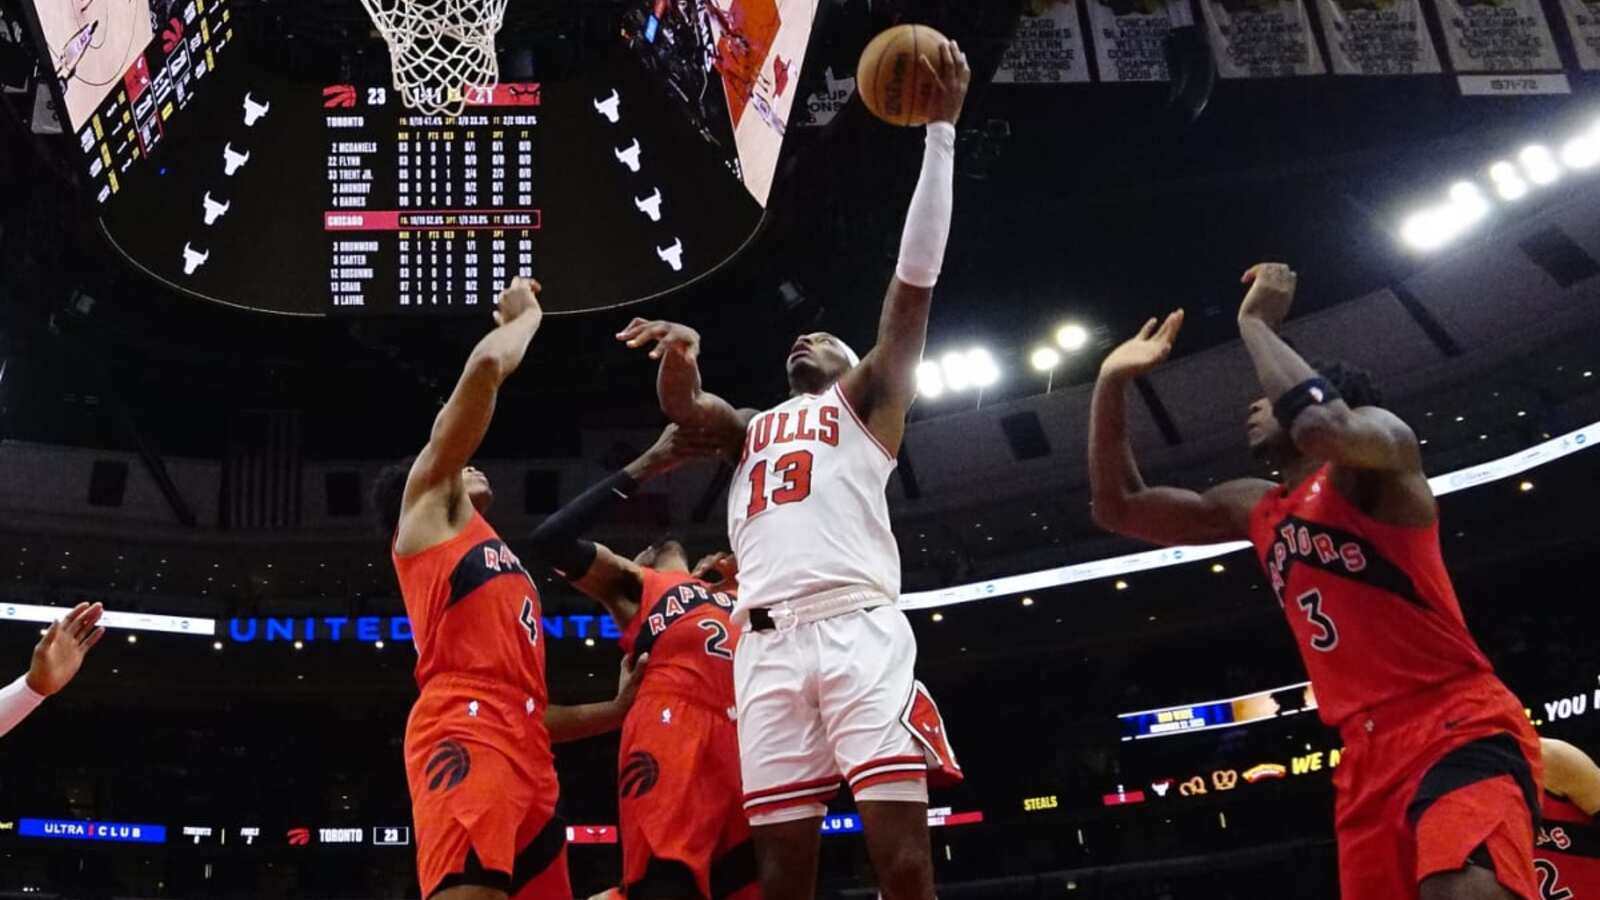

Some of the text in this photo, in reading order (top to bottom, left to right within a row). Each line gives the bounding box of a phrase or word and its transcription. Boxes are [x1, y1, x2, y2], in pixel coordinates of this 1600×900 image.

[367, 87, 386, 105] 23
[326, 116, 364, 127] TORONTO
[327, 215, 363, 226] CHICAGO
[747, 450, 813, 519] 13
[1267, 523, 1366, 608] APTORS
[519, 596, 538, 647] 4
[649, 585, 738, 636] RAPTO
[1298, 588, 1339, 652] 3
[698, 619, 734, 660] 2
[1544, 694, 1587, 722] YOU
[1292, 751, 1323, 775] WE
[1024, 797, 1058, 811] STEALS
[44, 823, 141, 838] ULTRA CLUB
[319, 828, 398, 842] TORONTO 23
[821, 817, 854, 830] LUB
[1533, 858, 1574, 900] 2
